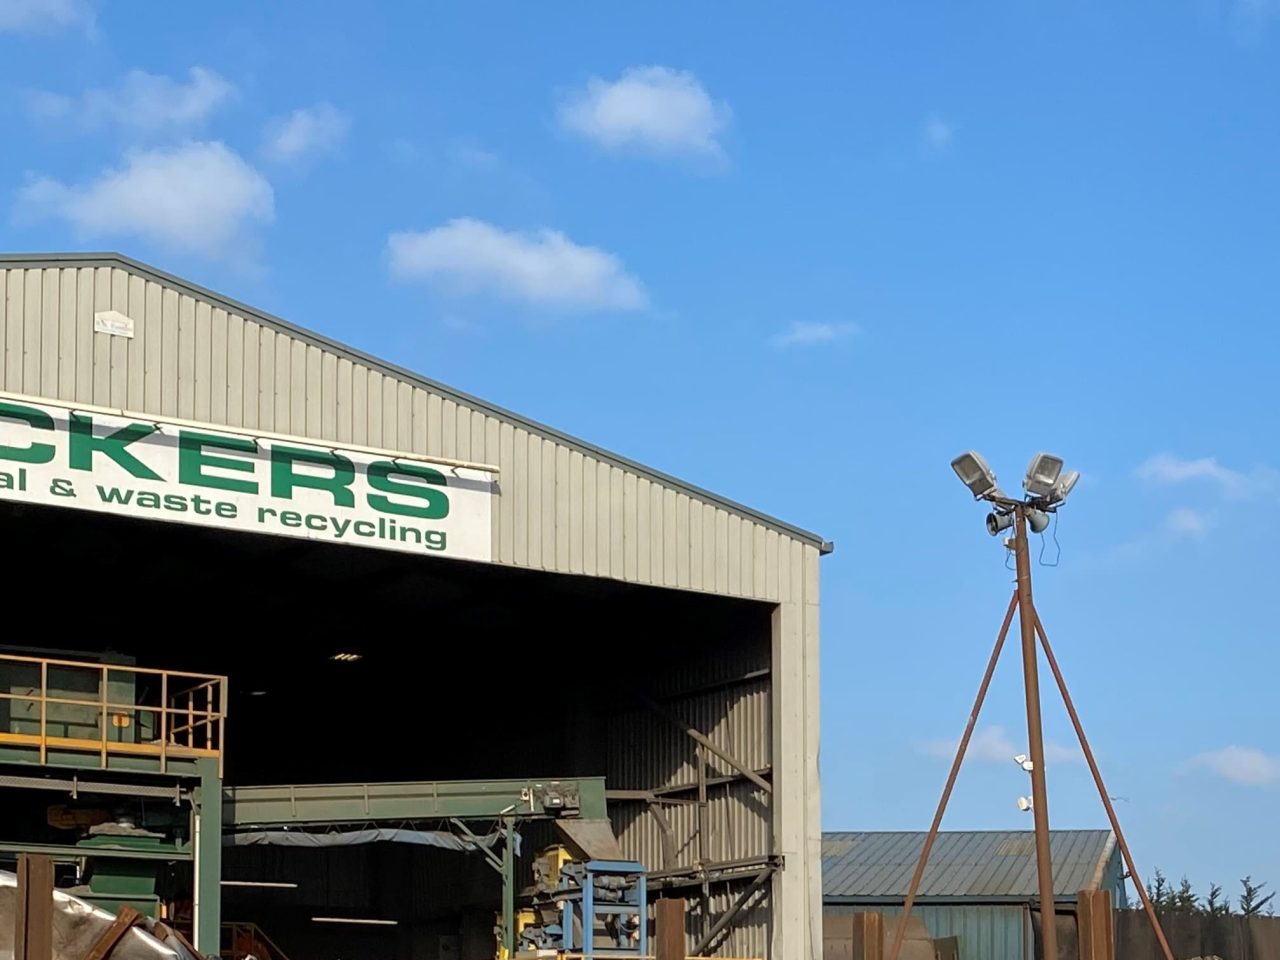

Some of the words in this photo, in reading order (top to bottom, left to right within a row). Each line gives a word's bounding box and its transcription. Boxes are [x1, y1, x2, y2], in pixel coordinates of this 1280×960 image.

[50, 478, 77, 497] &
[96, 485, 237, 519] waste
[258, 507, 447, 550] recycling
